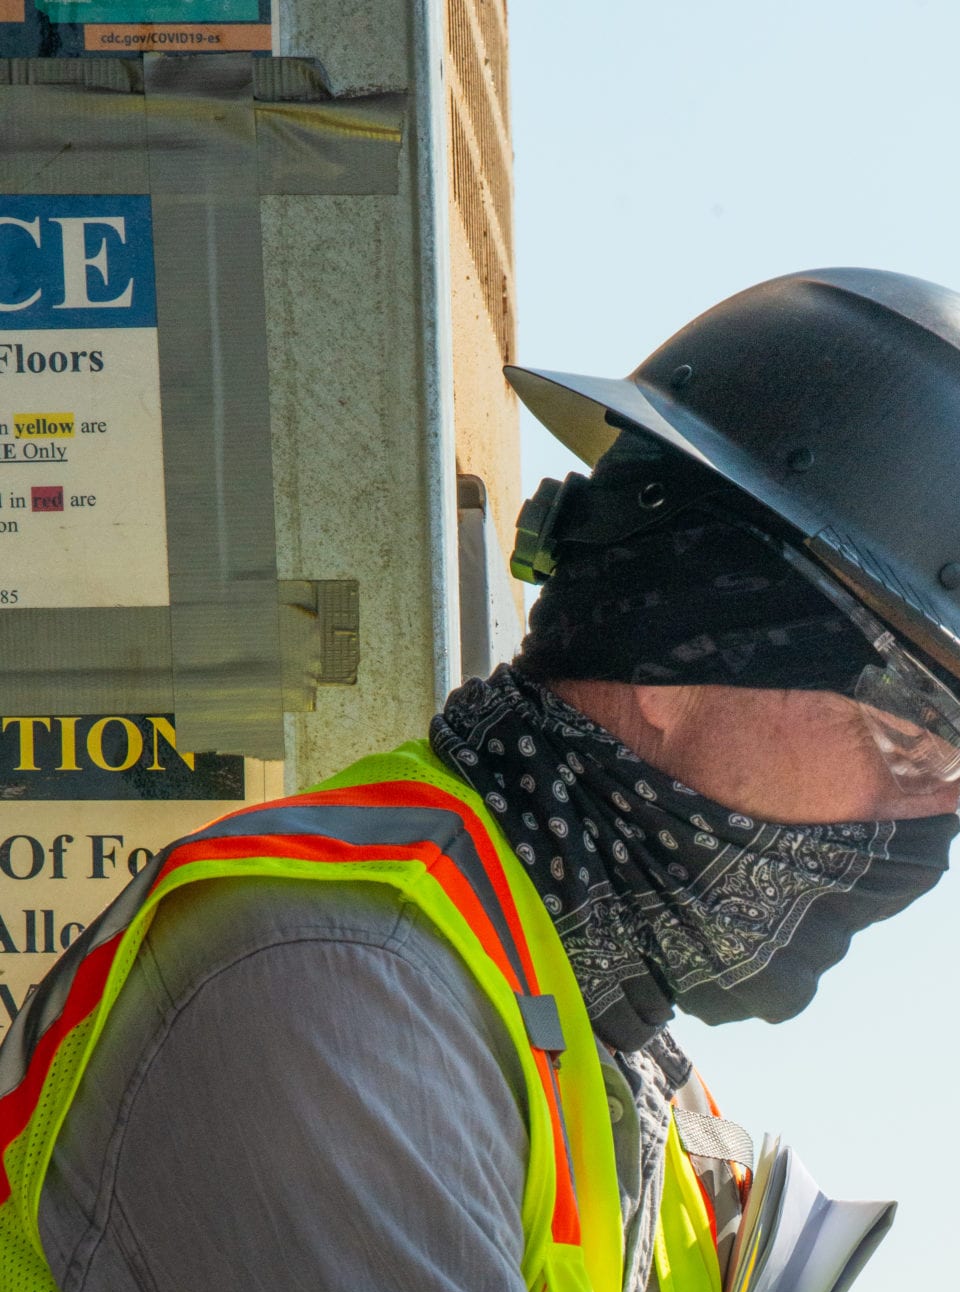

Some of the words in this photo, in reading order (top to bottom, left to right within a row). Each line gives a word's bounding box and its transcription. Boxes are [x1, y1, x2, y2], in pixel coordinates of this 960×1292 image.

[101, 32, 221, 46] cdc.gov/COVID19-es
[15, 418, 74, 439] yellow
[81, 421, 107, 433] are
[23, 442, 67, 460] Only
[10, 491, 26, 508] in
[32, 490, 63, 509] red
[70, 494, 97, 507] are
[2, 715, 196, 772] TION
[0, 834, 74, 880] Of
[86, 834, 165, 879] Fo
